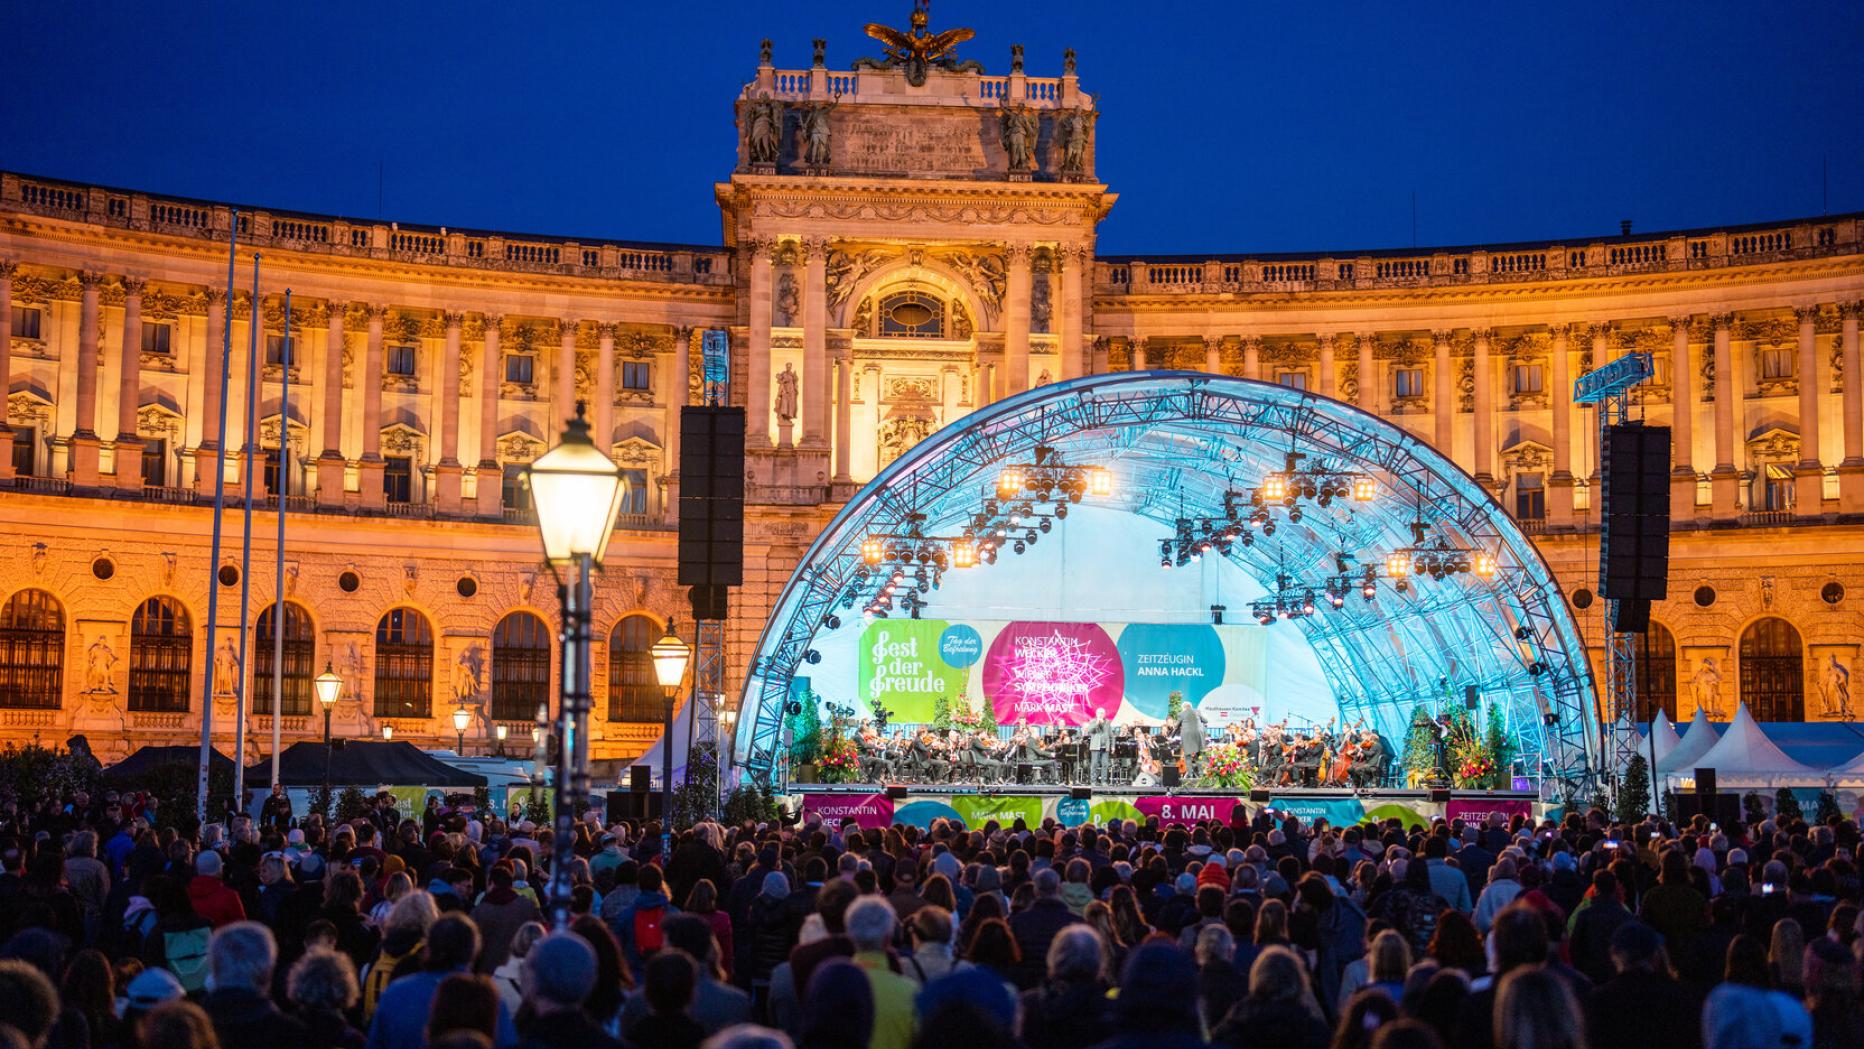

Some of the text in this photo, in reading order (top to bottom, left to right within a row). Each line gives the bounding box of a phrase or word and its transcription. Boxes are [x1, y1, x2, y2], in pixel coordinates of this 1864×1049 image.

[1015, 636, 1079, 646] KONSTANTIN
[872, 631, 918, 664] Fest
[1137, 654, 1194, 664] ZEITZEUGIN
[889, 658, 923, 675] der
[1137, 667, 1204, 677] ANNA HACKL
[869, 665, 945, 697] Freude
[1014, 703, 1074, 713] MARK MAST
[817, 805, 878, 815] KONSTANTIN
[1161, 804, 1215, 820] 8. MAI
[1000, 811, 1026, 820] MAST
